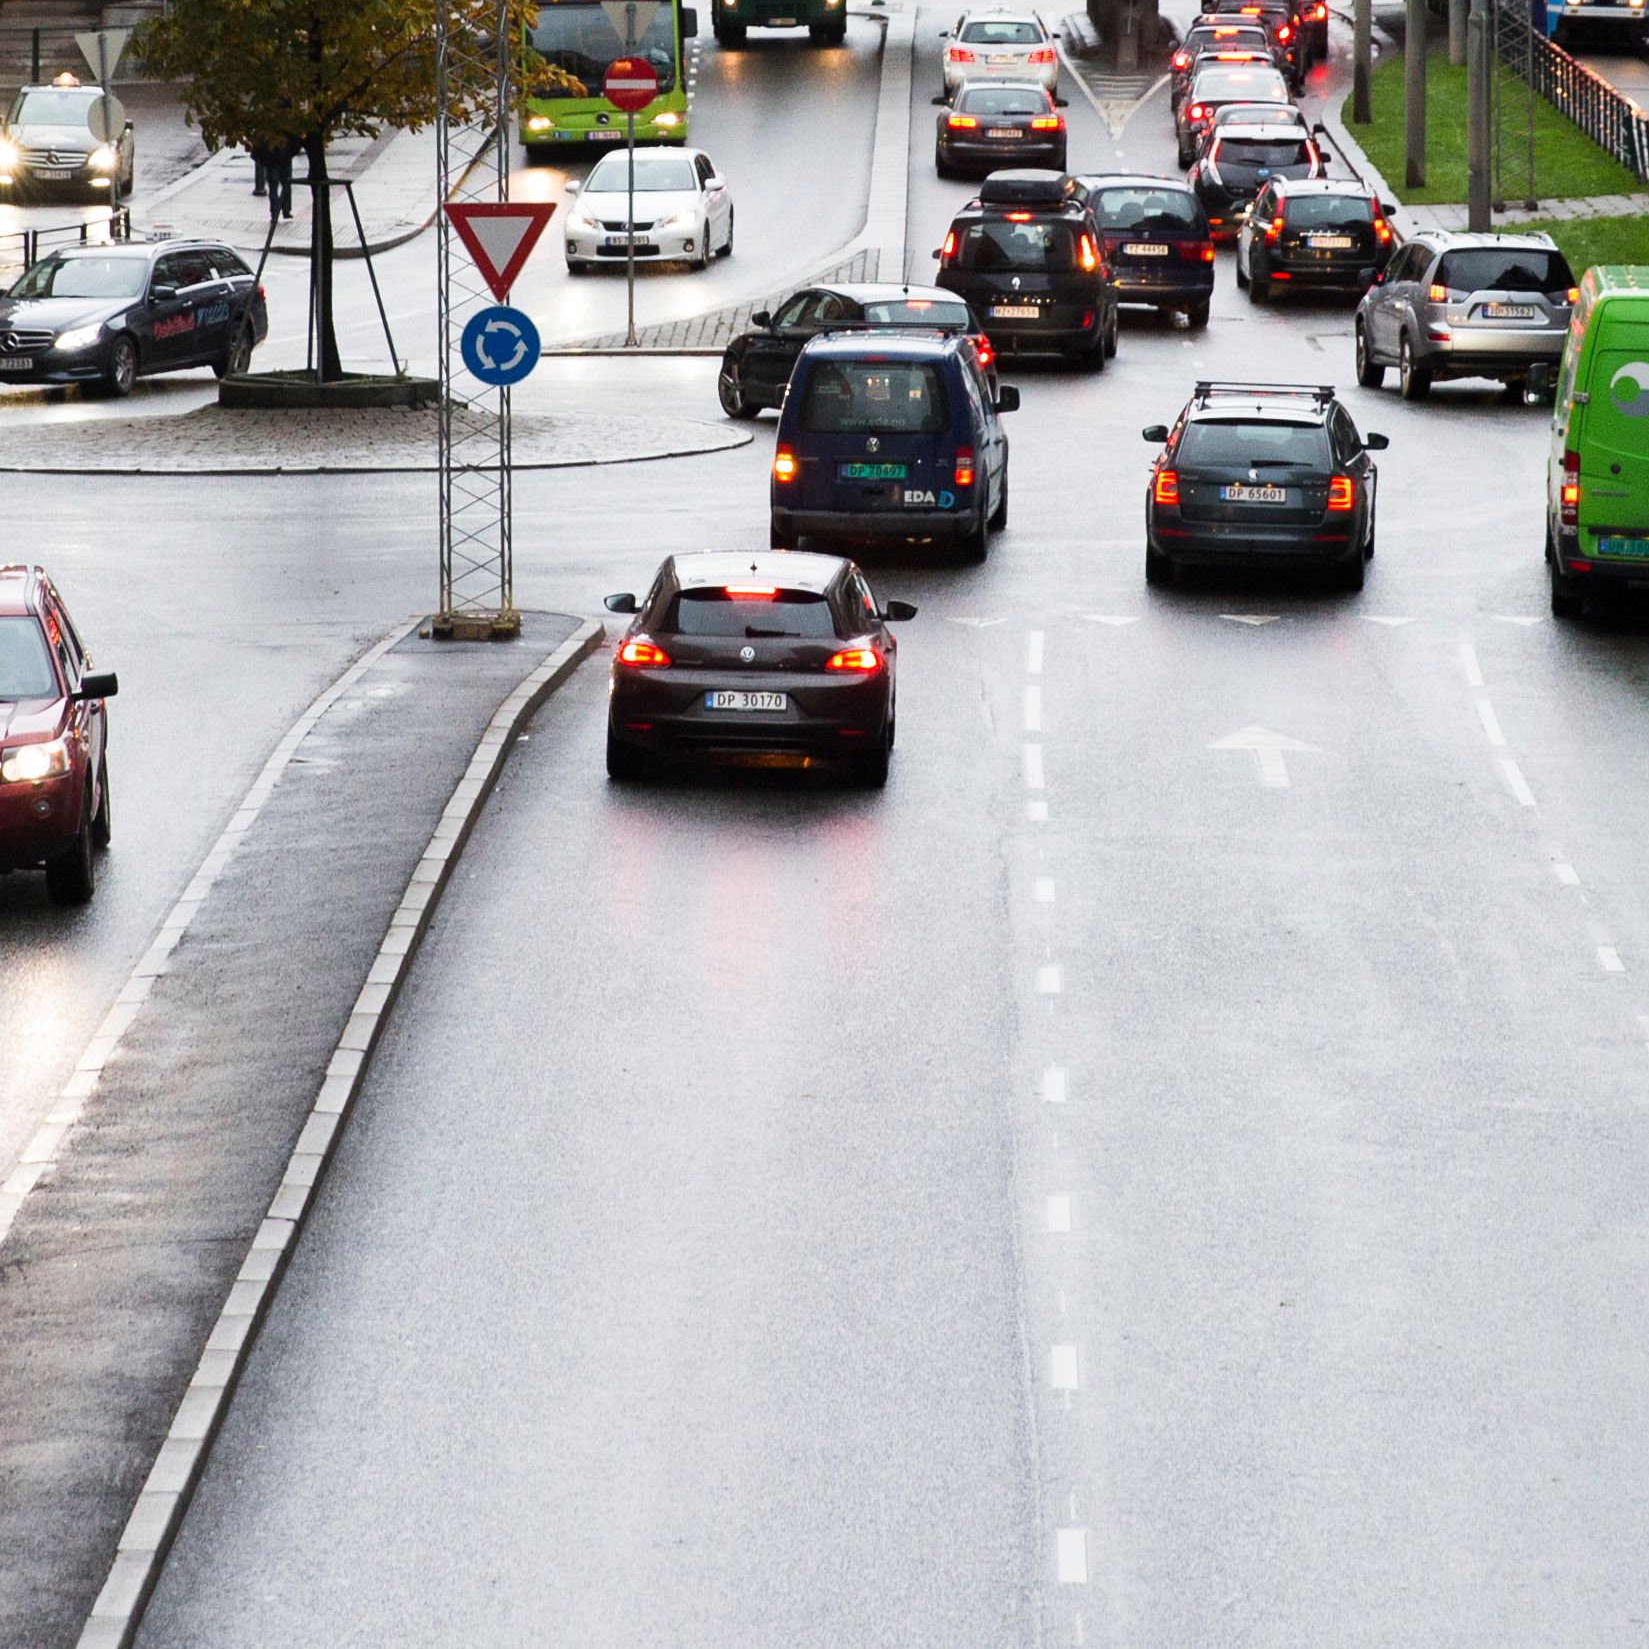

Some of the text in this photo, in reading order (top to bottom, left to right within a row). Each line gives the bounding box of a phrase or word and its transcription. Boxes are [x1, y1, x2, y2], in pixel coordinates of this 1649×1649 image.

[904, 490, 936, 503] EDA
[1229, 489, 1282, 500] DP 65601
[717, 693, 782, 708] DP 30170
